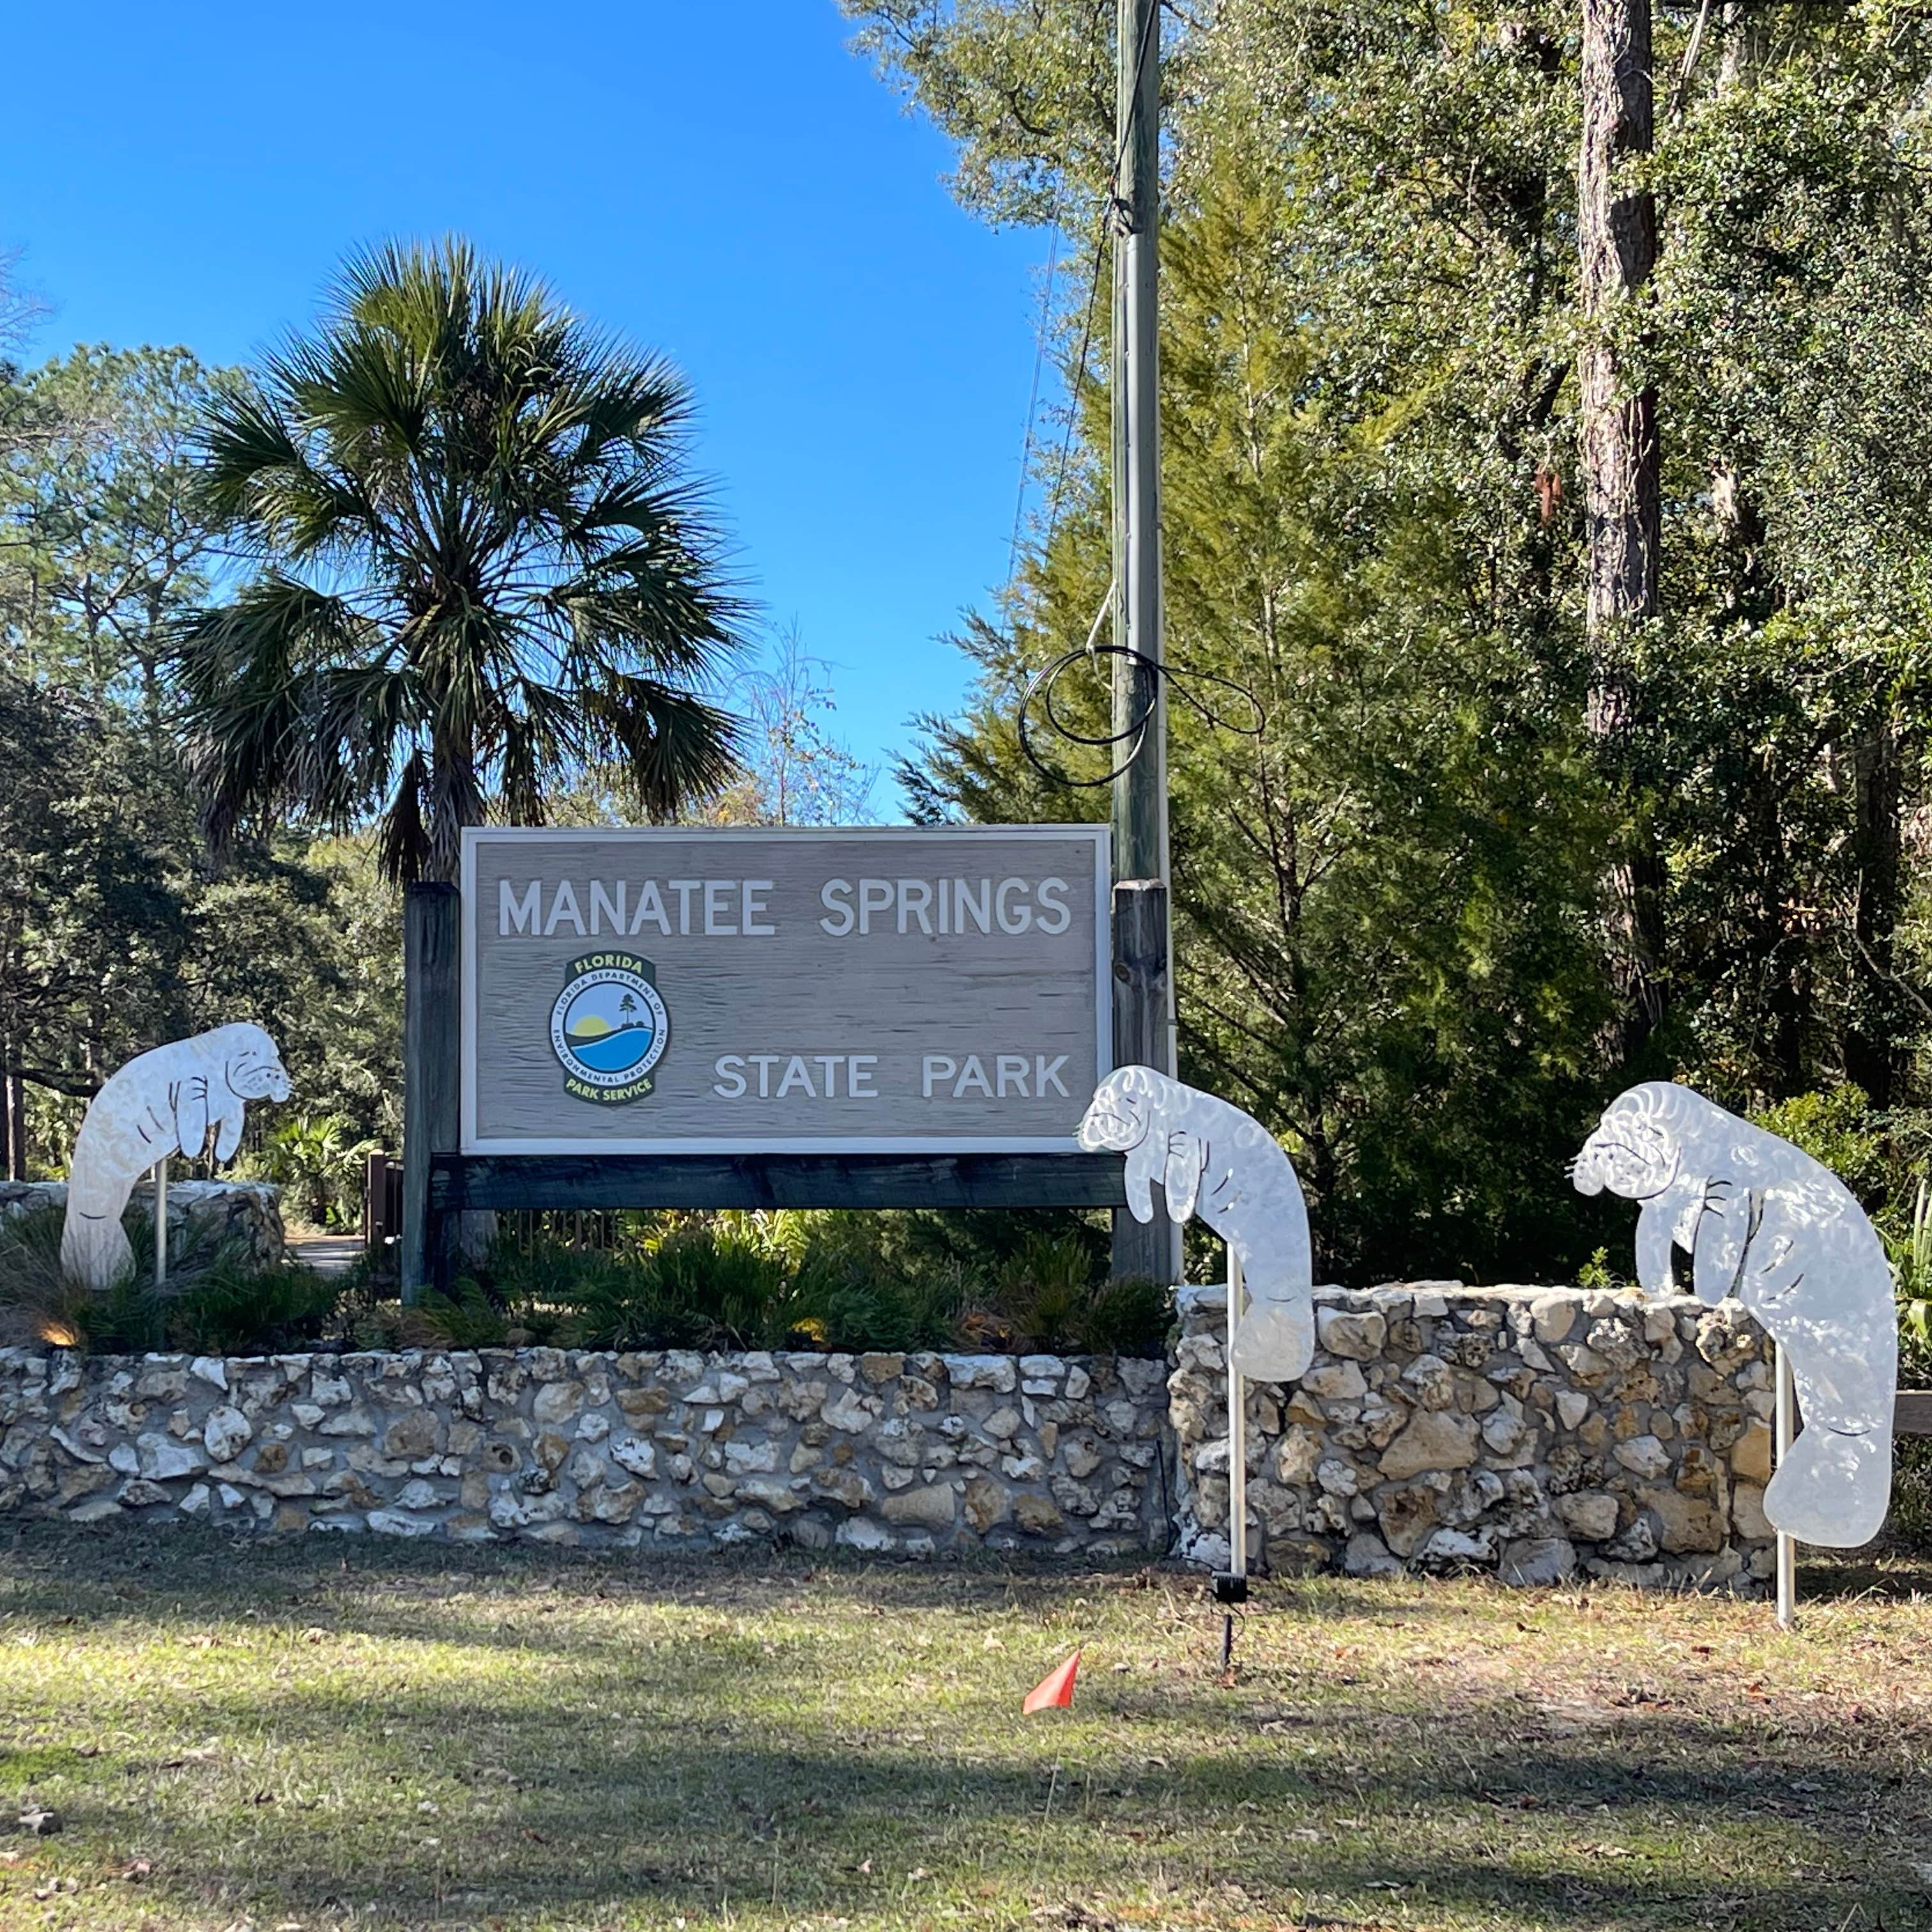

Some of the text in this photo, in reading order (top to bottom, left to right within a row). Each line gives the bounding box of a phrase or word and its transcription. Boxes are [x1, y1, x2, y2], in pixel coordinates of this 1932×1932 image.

[498, 877, 1072, 937] MANATEE SPRINGS
[574, 954, 643, 974] FLORIDA
[555, 972, 664, 1016] FLORIDA DEPARTMENT OF
[553, 1029, 665, 1083] ENVIRONMENTAL PROTECTION
[712, 1054, 1071, 1099] STATE PARK
[565, 1078, 653, 1101] PARK SERVICE
